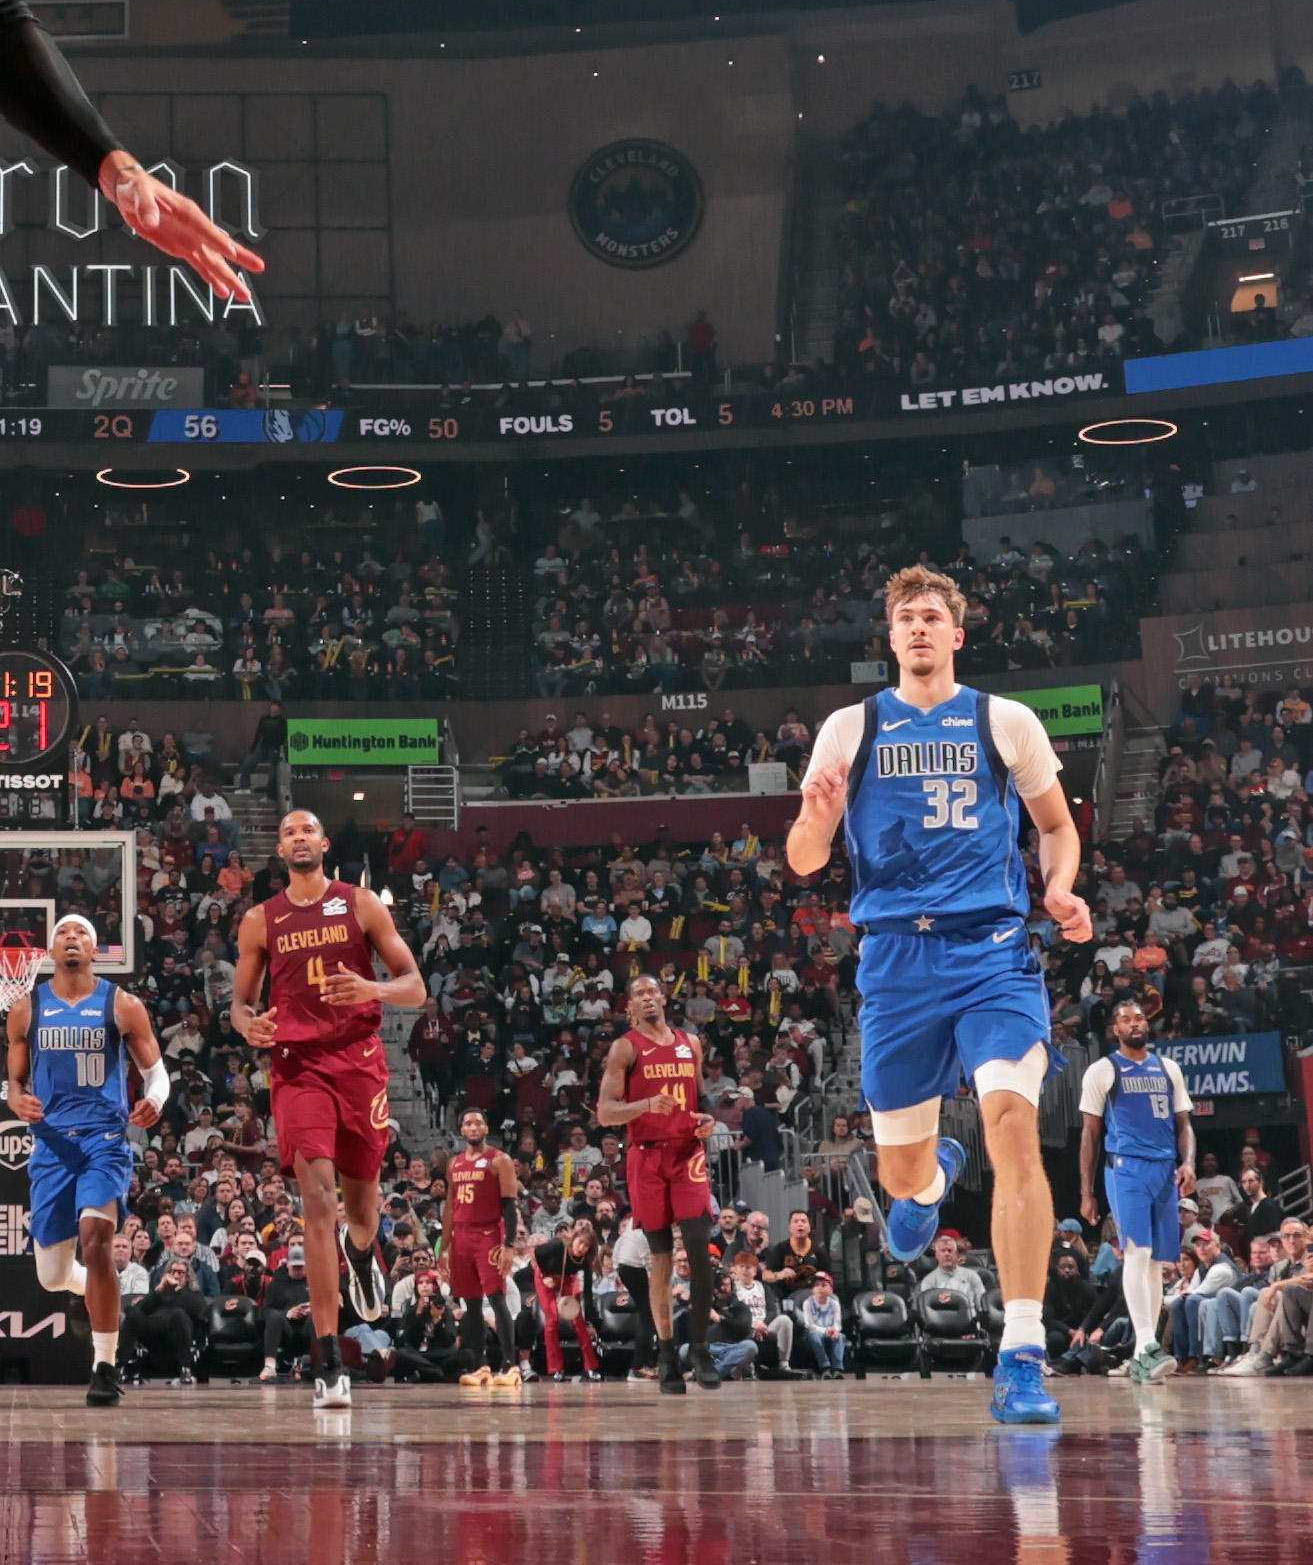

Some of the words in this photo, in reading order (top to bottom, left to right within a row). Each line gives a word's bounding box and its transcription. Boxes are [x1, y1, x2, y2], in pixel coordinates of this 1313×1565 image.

[589, 150, 680, 183] CLEVELAND
[1221, 224, 1245, 238] 217
[1263, 218, 1289, 232] 218
[595, 226, 679, 258] MONSTERS
[75, 368, 179, 405] Sprite
[901, 390, 957, 410] LET
[962, 385, 1006, 405] EM
[1009, 373, 1109, 399] KNOW.
[651, 408, 696, 426] TOL
[719, 404, 733, 424] 5
[771, 400, 815, 419] 4:30
[822, 398, 854, 415] PM
[94, 415, 134, 438] 2Q
[184, 415, 218, 438] 56
[360, 418, 411, 436] FG%
[428, 419, 458, 438] 50
[500, 415, 573, 434] FOULS
[599, 411, 613, 431] 5
[1208, 626, 1313, 651] LITEHOU
[4, 671, 53, 698] 1:19
[661, 693, 708, 711] M115
[1062, 702, 1101, 718] Bank
[941, 716, 974, 727] chime
[312, 734, 395, 753] Huntington
[399, 734, 436, 749] Bank
[877, 741, 978, 778] DALLAS
[923, 779, 979, 828] 32
[277, 924, 349, 954] CLEVELAND
[307, 955, 328, 994] 4
[38, 1027, 106, 1050] DALLAS
[75, 1052, 105, 1087] 10
[643, 1063, 695, 1079] CLEVELAND
[1121, 1077, 1168, 1094] DALLAS
[1150, 1094, 1170, 1119] 13
[452, 1171, 485, 1182] CLEVELAND
[457, 1183, 475, 1204] 45
